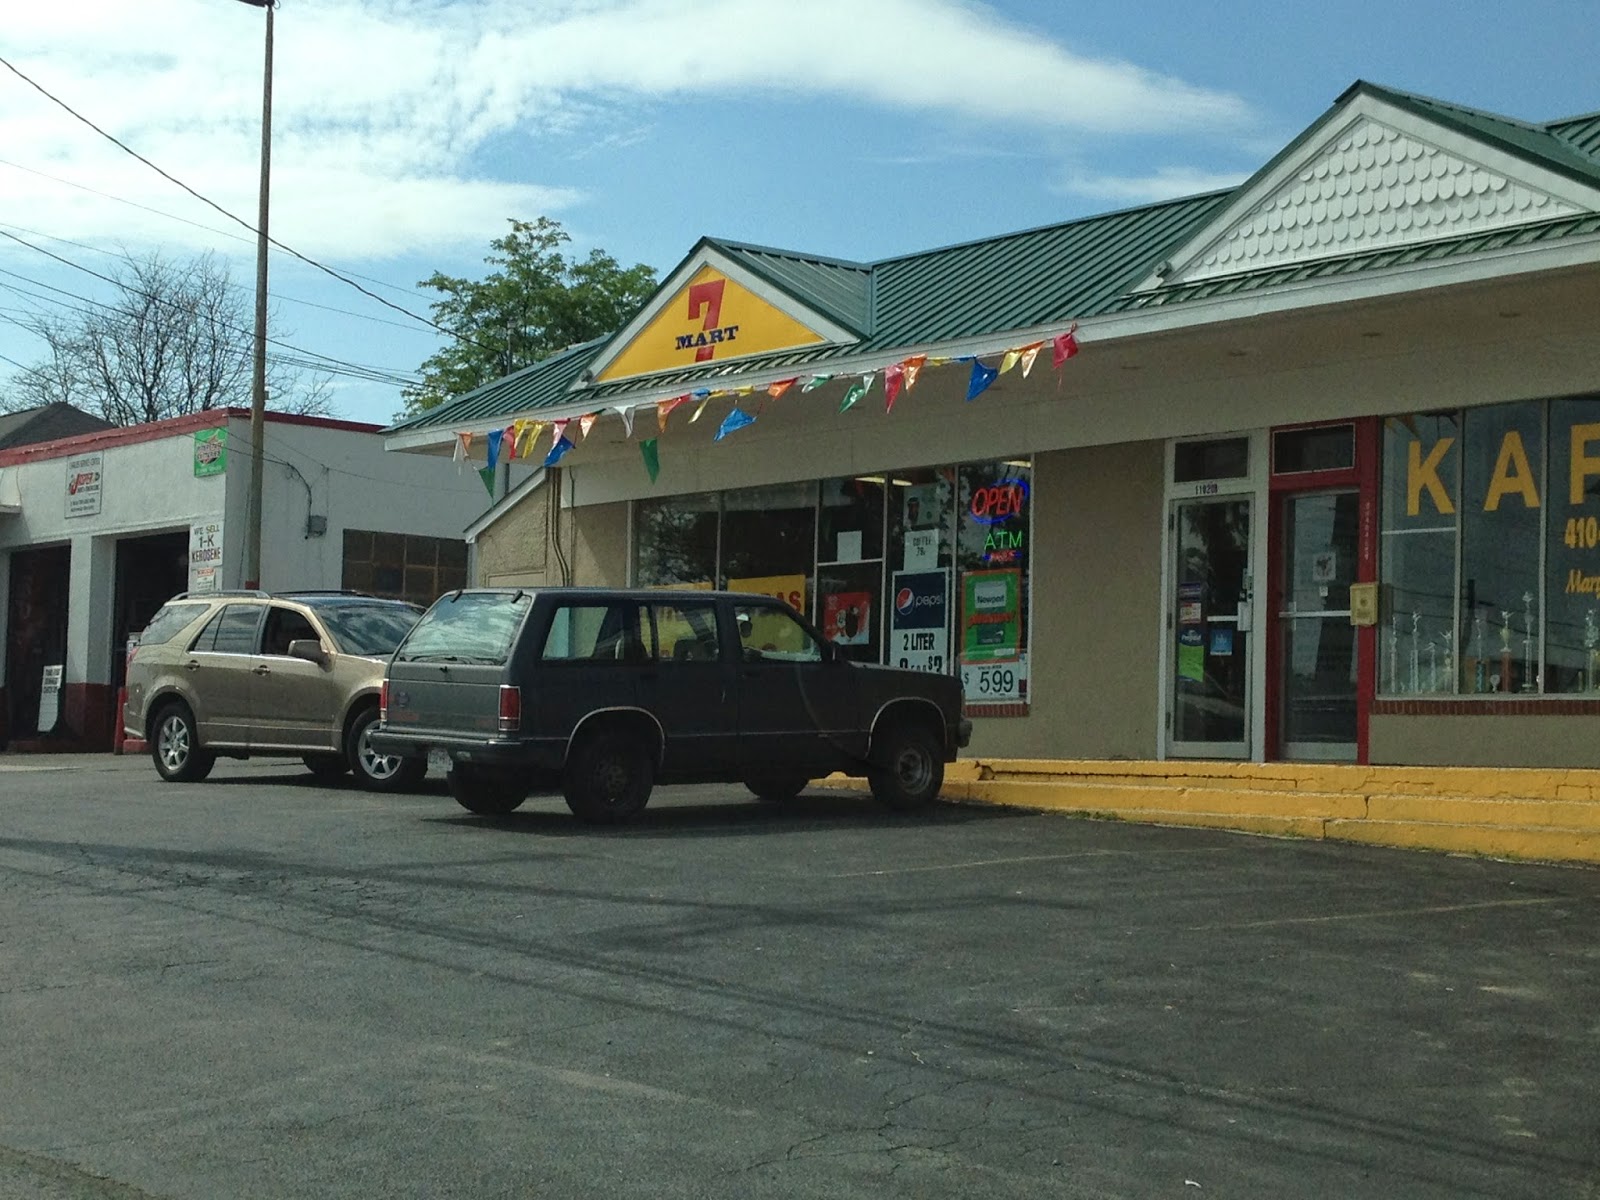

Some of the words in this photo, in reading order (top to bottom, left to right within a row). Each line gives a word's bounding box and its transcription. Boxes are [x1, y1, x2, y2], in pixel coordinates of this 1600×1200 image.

[688, 279, 726, 362] 7
[675, 325, 739, 350] MART
[971, 486, 1024, 516] OPEN
[206, 524, 220, 533] SELL
[1564, 516, 1600, 549] 410
[199, 534, 214, 548] 1-K
[984, 530, 1023, 551] ATM
[191, 547, 221, 563] KEROSENE
[915, 594, 944, 607] pepsi
[977, 595, 1005, 604] Newport
[903, 633, 909, 651] 2
[911, 633, 935, 651] LITER
[979, 670, 1014, 693] 599
